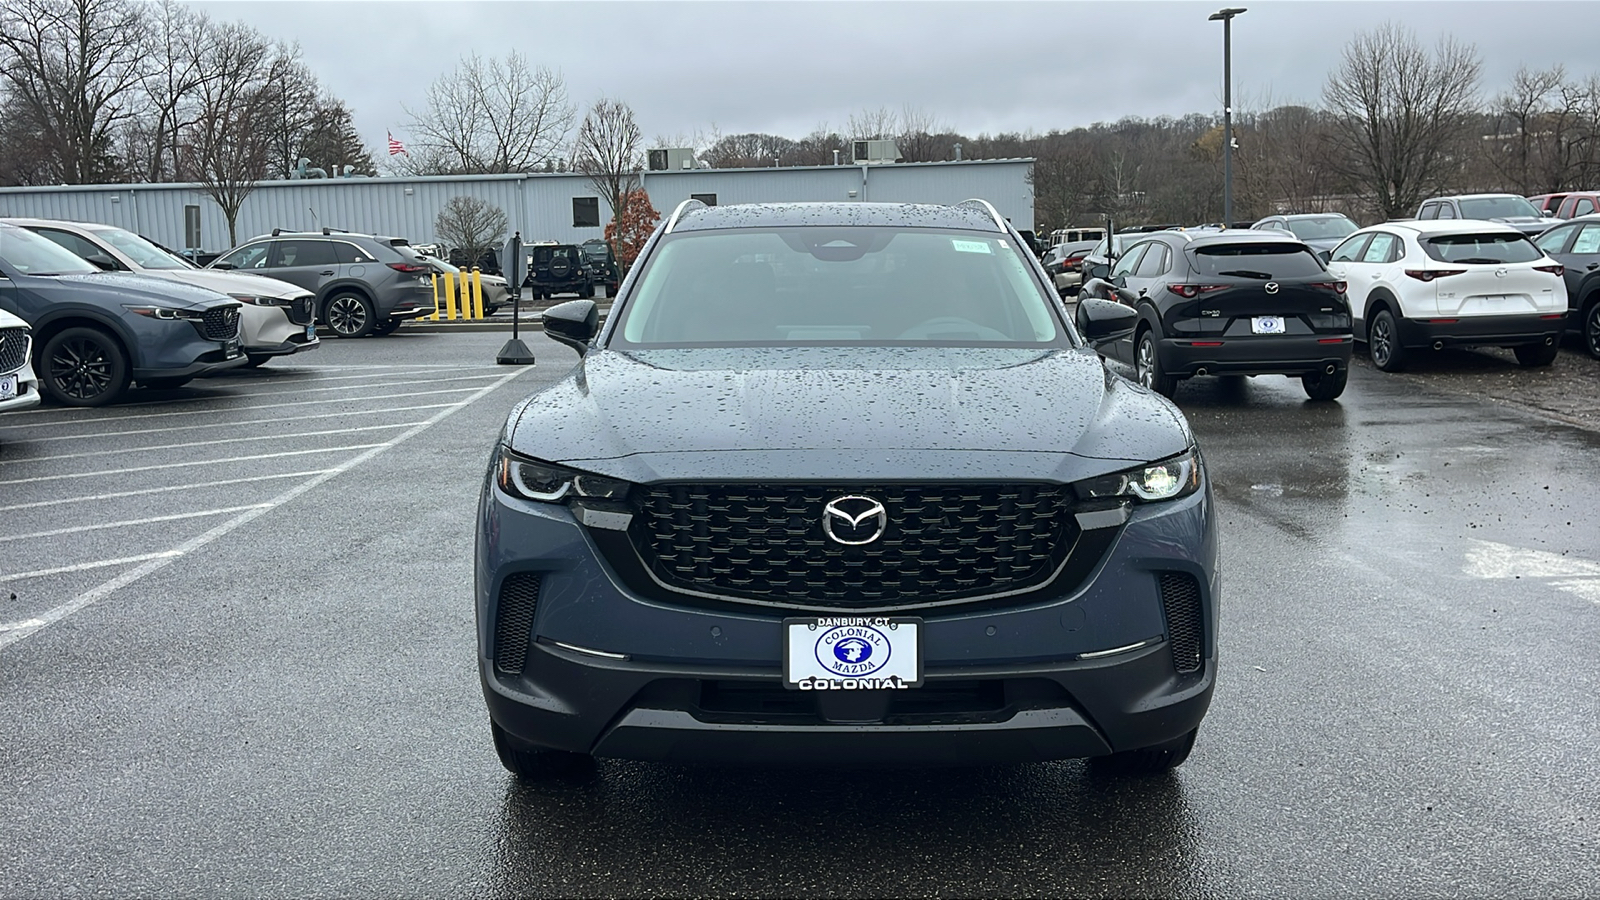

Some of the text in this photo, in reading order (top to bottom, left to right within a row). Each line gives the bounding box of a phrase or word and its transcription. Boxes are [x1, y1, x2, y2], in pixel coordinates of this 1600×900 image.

[817, 617, 890, 626] DANBURY, CT
[825, 628, 881, 646] COLONIAL
[832, 661, 876, 673] MAZDA
[798, 679, 908, 690] COLONIAL
